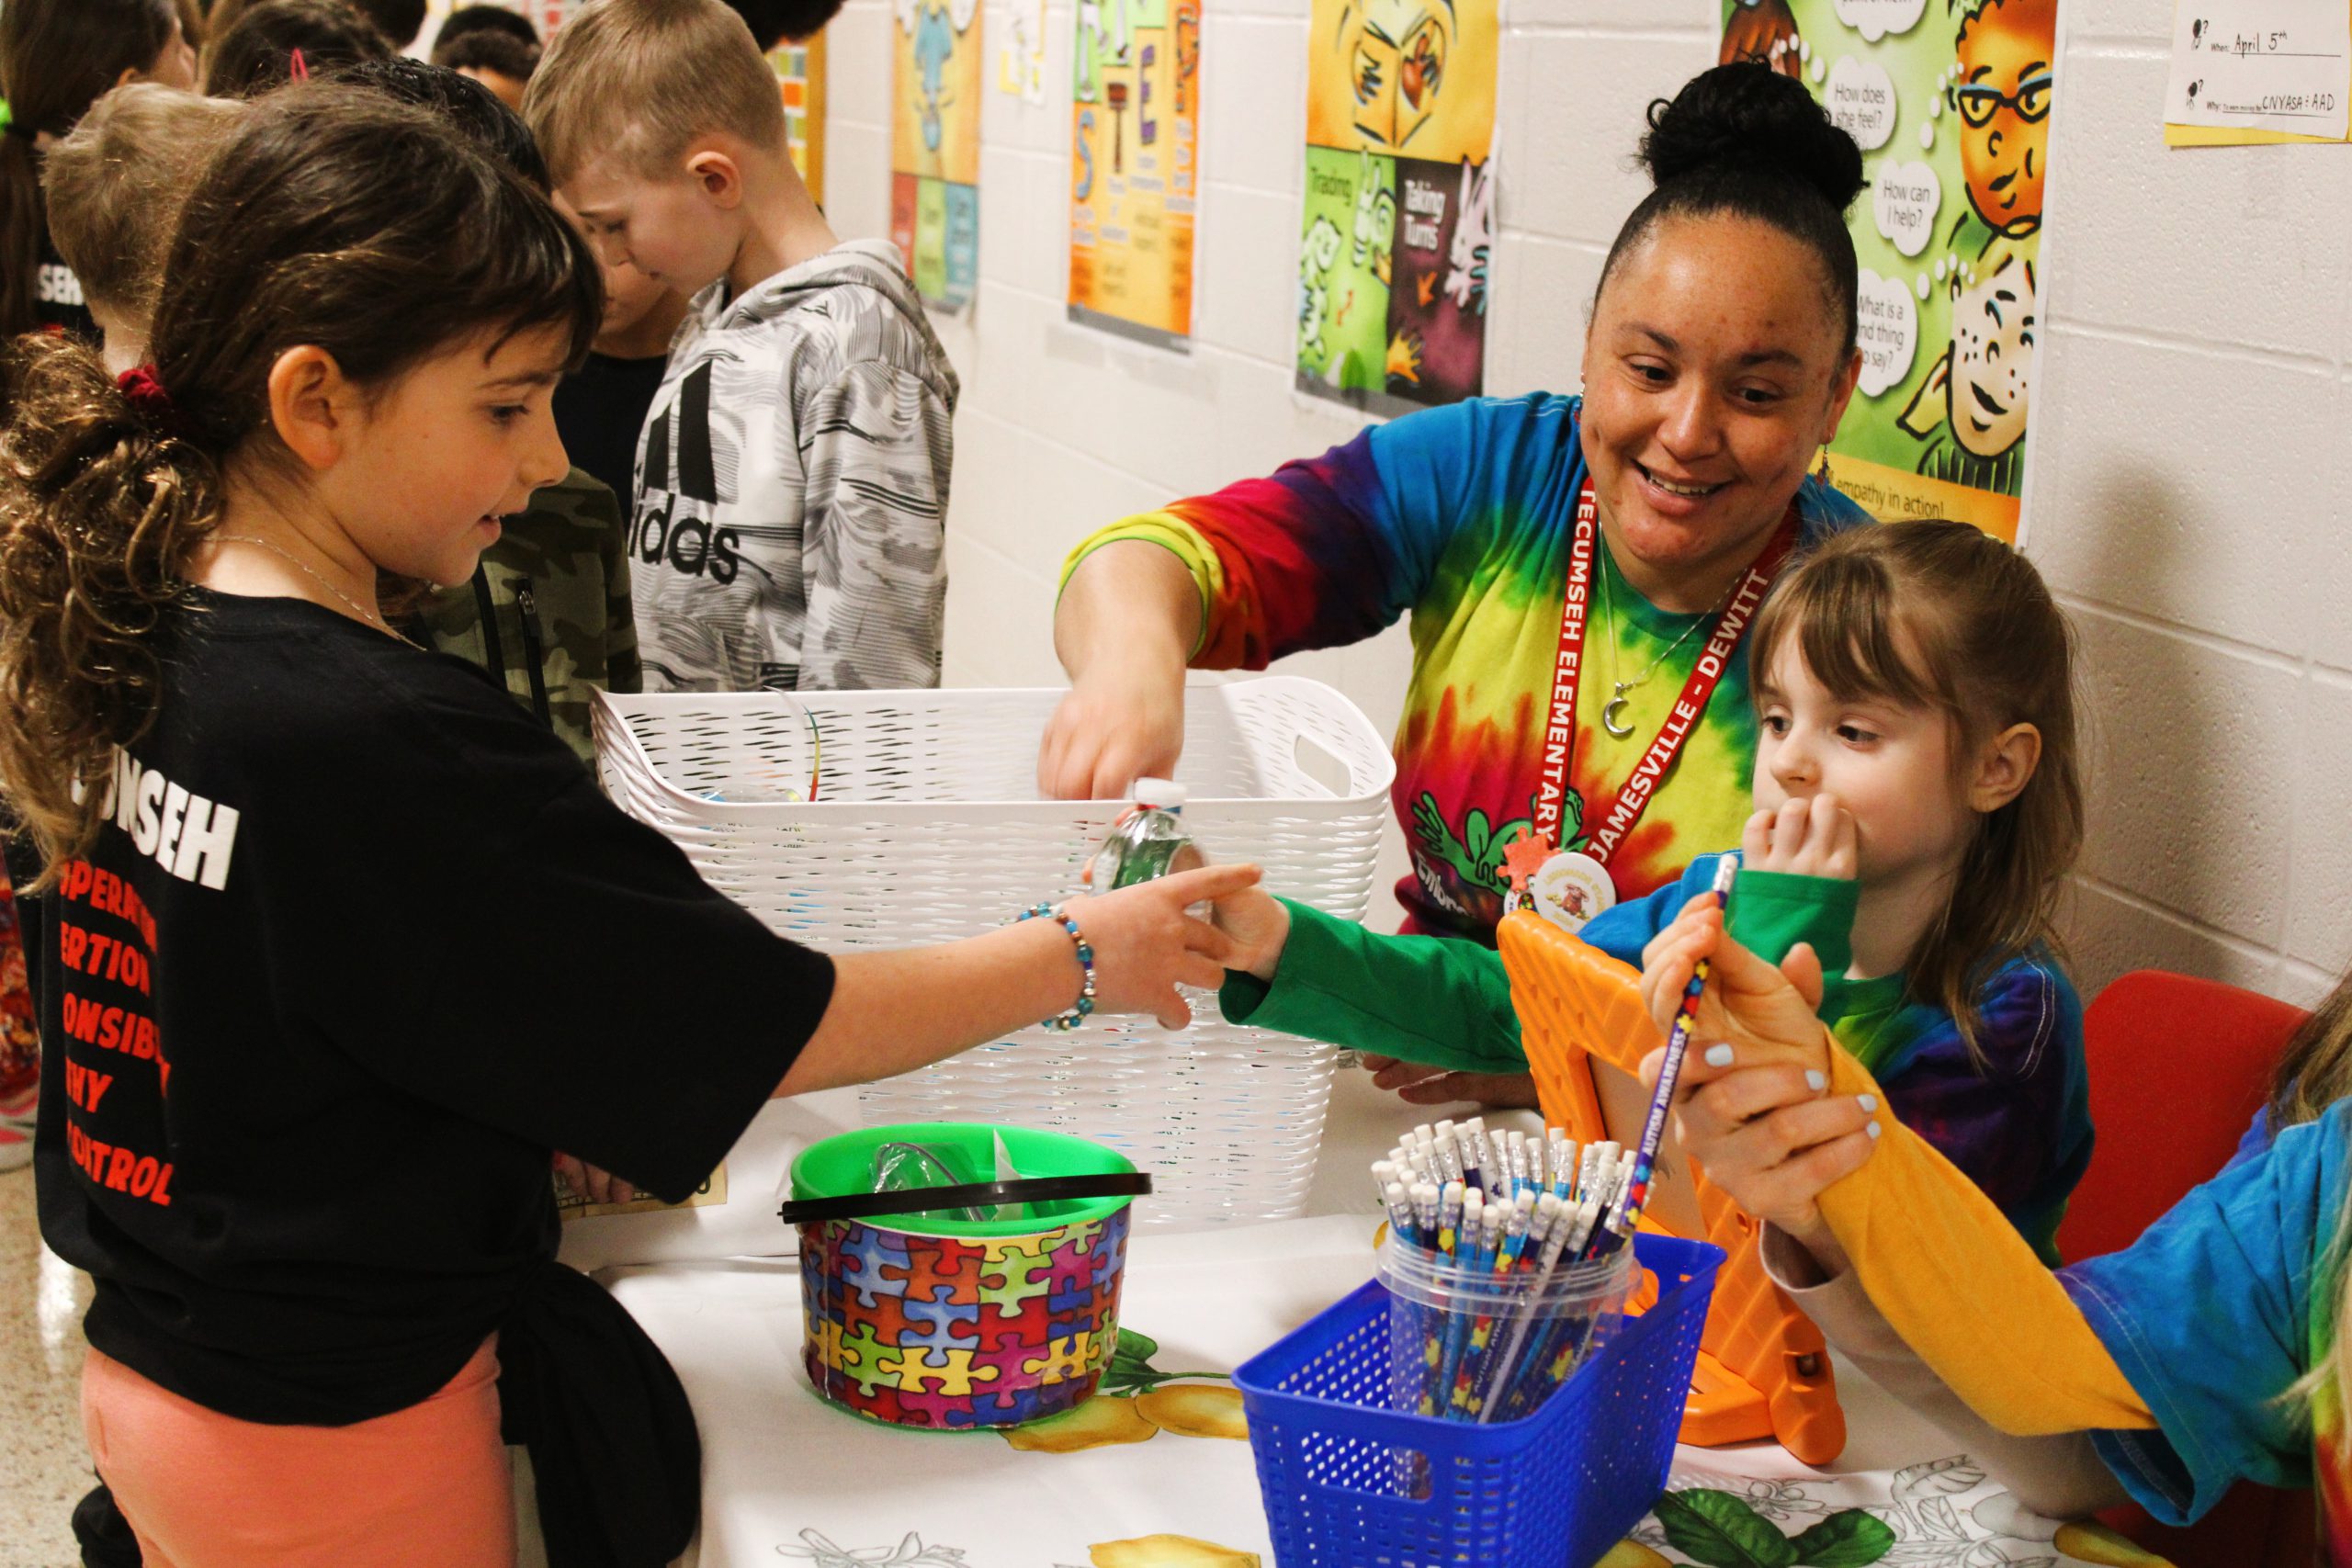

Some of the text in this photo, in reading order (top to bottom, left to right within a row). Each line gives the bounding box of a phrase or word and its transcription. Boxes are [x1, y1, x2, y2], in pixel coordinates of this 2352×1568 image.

[2234, 32, 2260, 59] April
[2268, 29, 2288, 51] 5th
[1834, 83, 1886, 105] How does
[2262, 94, 2303, 111] CNYASA
[2311, 93, 2335, 111] AAD
[1837, 107, 1883, 130] she feel?
[1405, 179, 1447, 225] Taking
[1883, 179, 1930, 203] How can
[1405, 213, 1440, 252] Turns
[1887, 207, 1924, 231] I help?
[1887, 299, 1895, 319] is
[1896, 304, 1905, 321] a
[1877, 324, 1905, 352] thing
[1872, 350, 1894, 374] say?
[1836, 479, 1945, 520] empathy in action!
[1563, 489, 1597, 641] TECUMSEH
[1589, 699, 1697, 863] JAMESVILLE
[1697, 568, 1770, 680] DEWITT
[1535, 649, 1578, 843] ELEMENTARY
[1642, 1031, 1687, 1157] AUTISM AWARENESS
